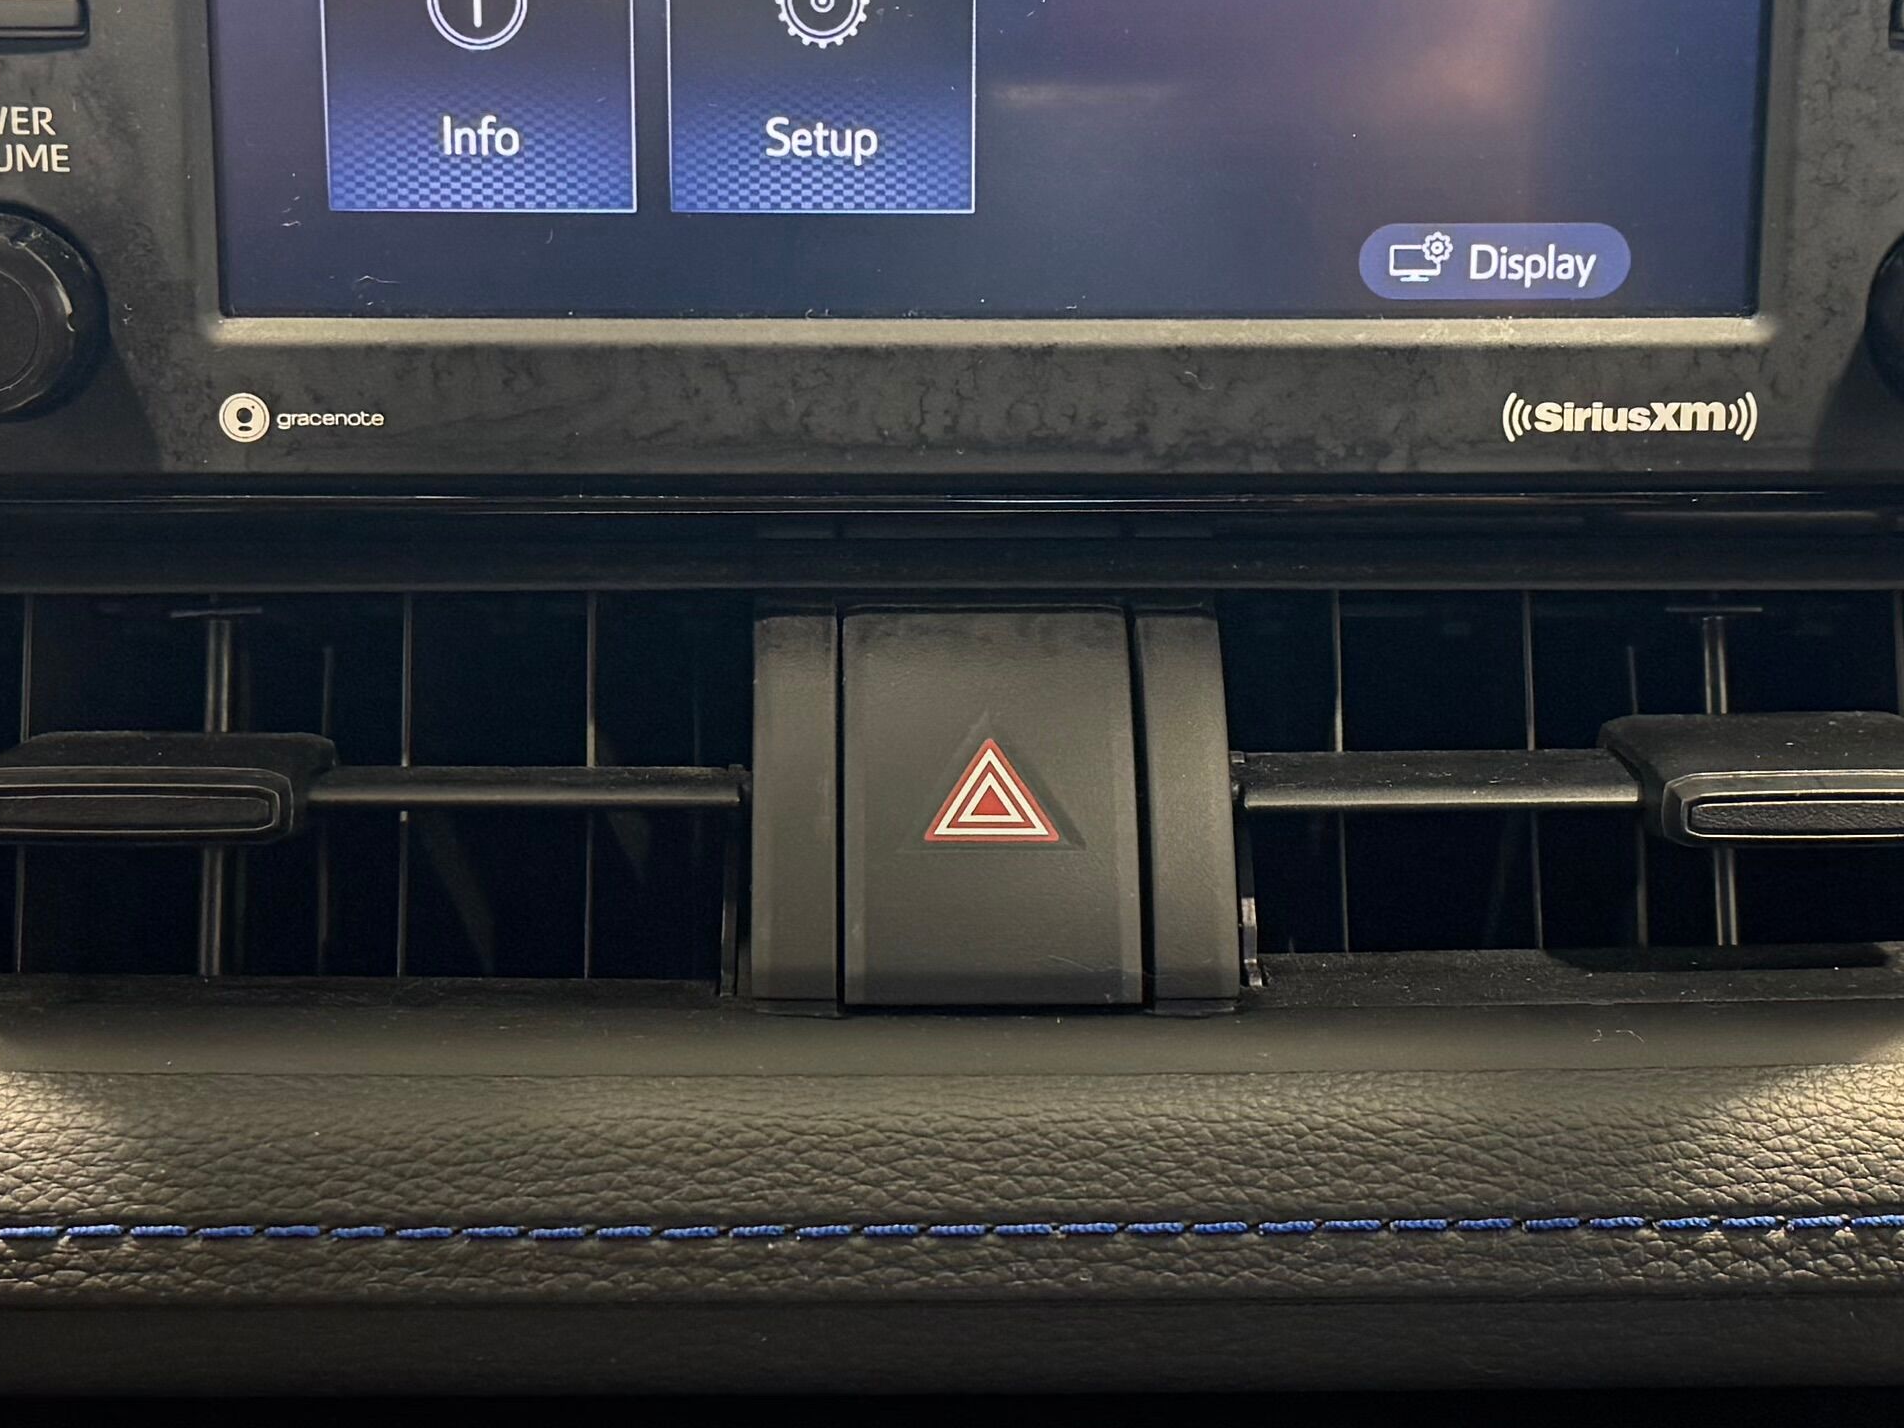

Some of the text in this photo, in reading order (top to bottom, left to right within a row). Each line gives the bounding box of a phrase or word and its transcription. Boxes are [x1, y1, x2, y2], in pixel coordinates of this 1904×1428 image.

[442, 116, 521, 157] Info
[764, 115, 879, 165] Setup
[1469, 244, 1597, 288] Display
[276, 410, 385, 431] gracenote
